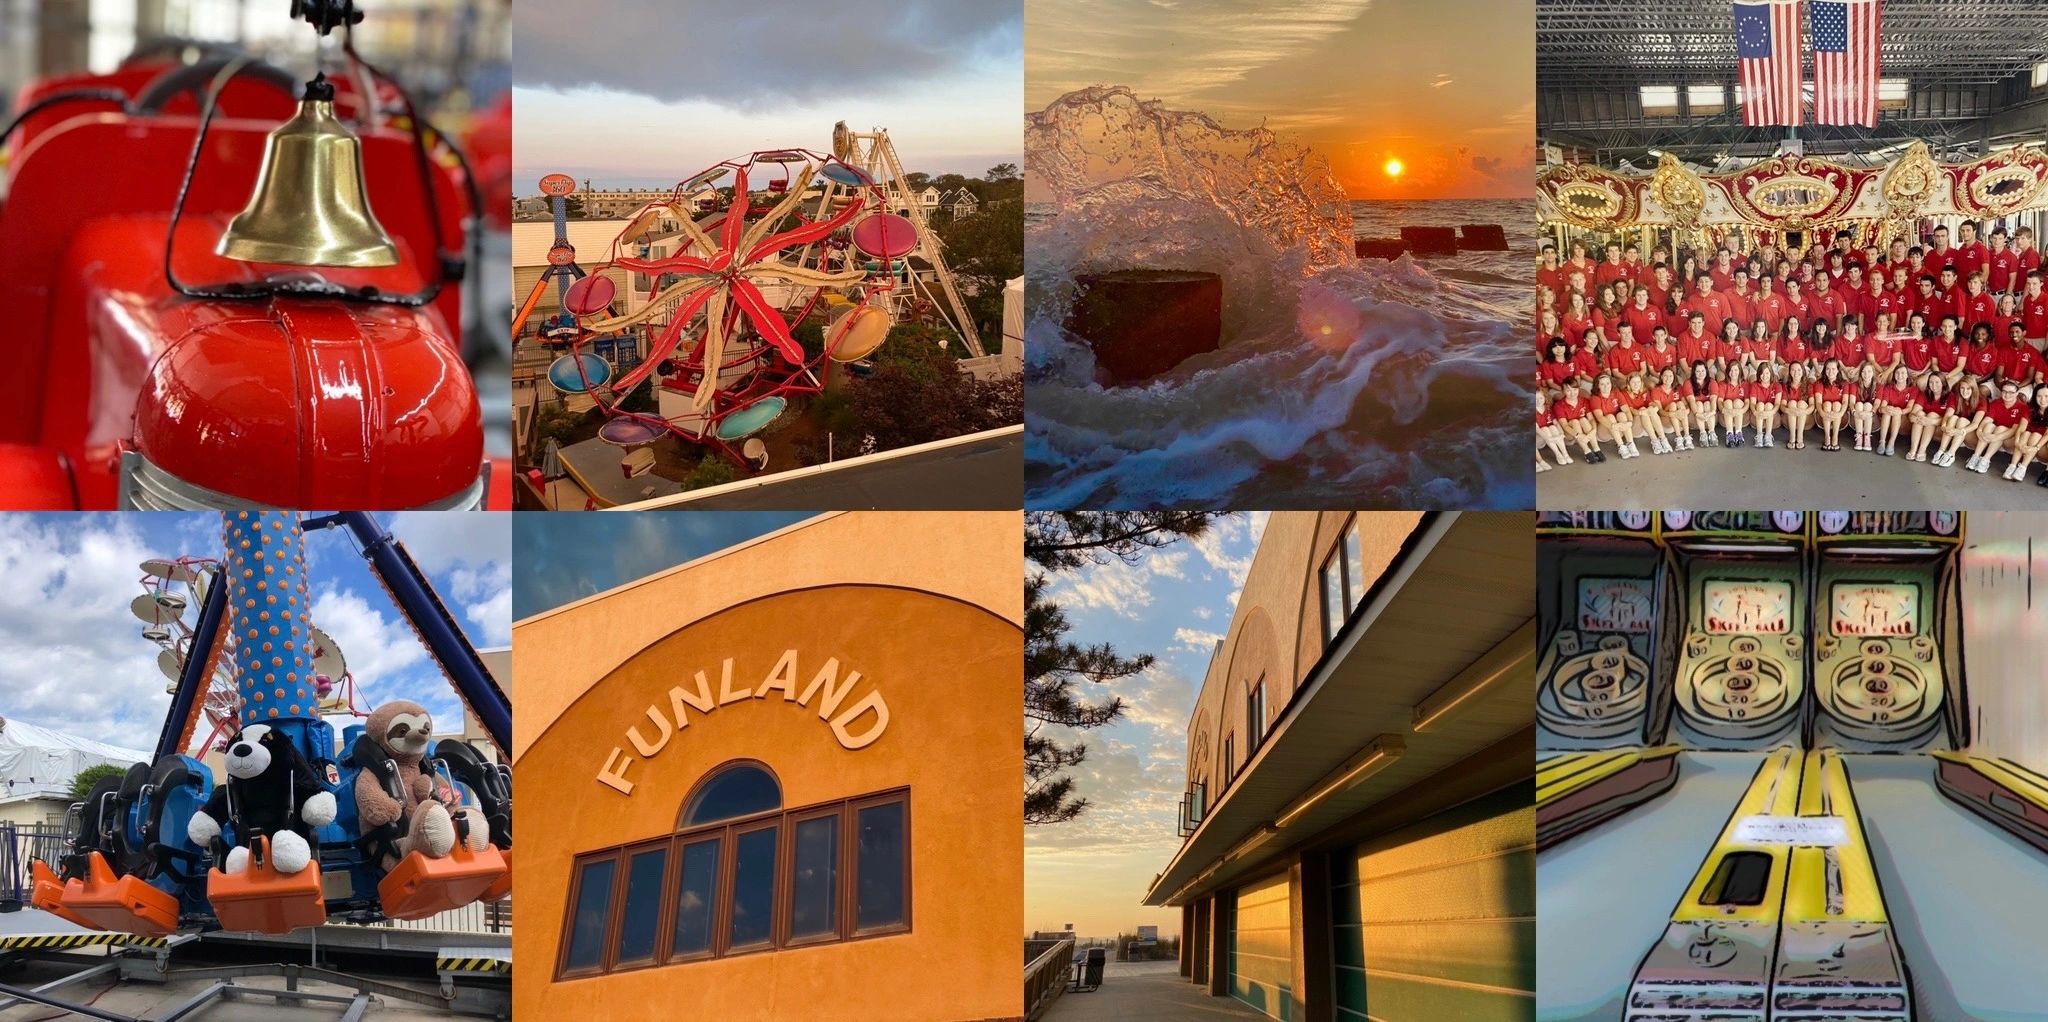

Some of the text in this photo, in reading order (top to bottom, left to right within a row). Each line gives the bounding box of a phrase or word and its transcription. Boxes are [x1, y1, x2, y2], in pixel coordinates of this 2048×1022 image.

[1728, 708, 1745, 718] 10
[1872, 712, 1889, 721] 10
[596, 649, 890, 796] FUNLAND
